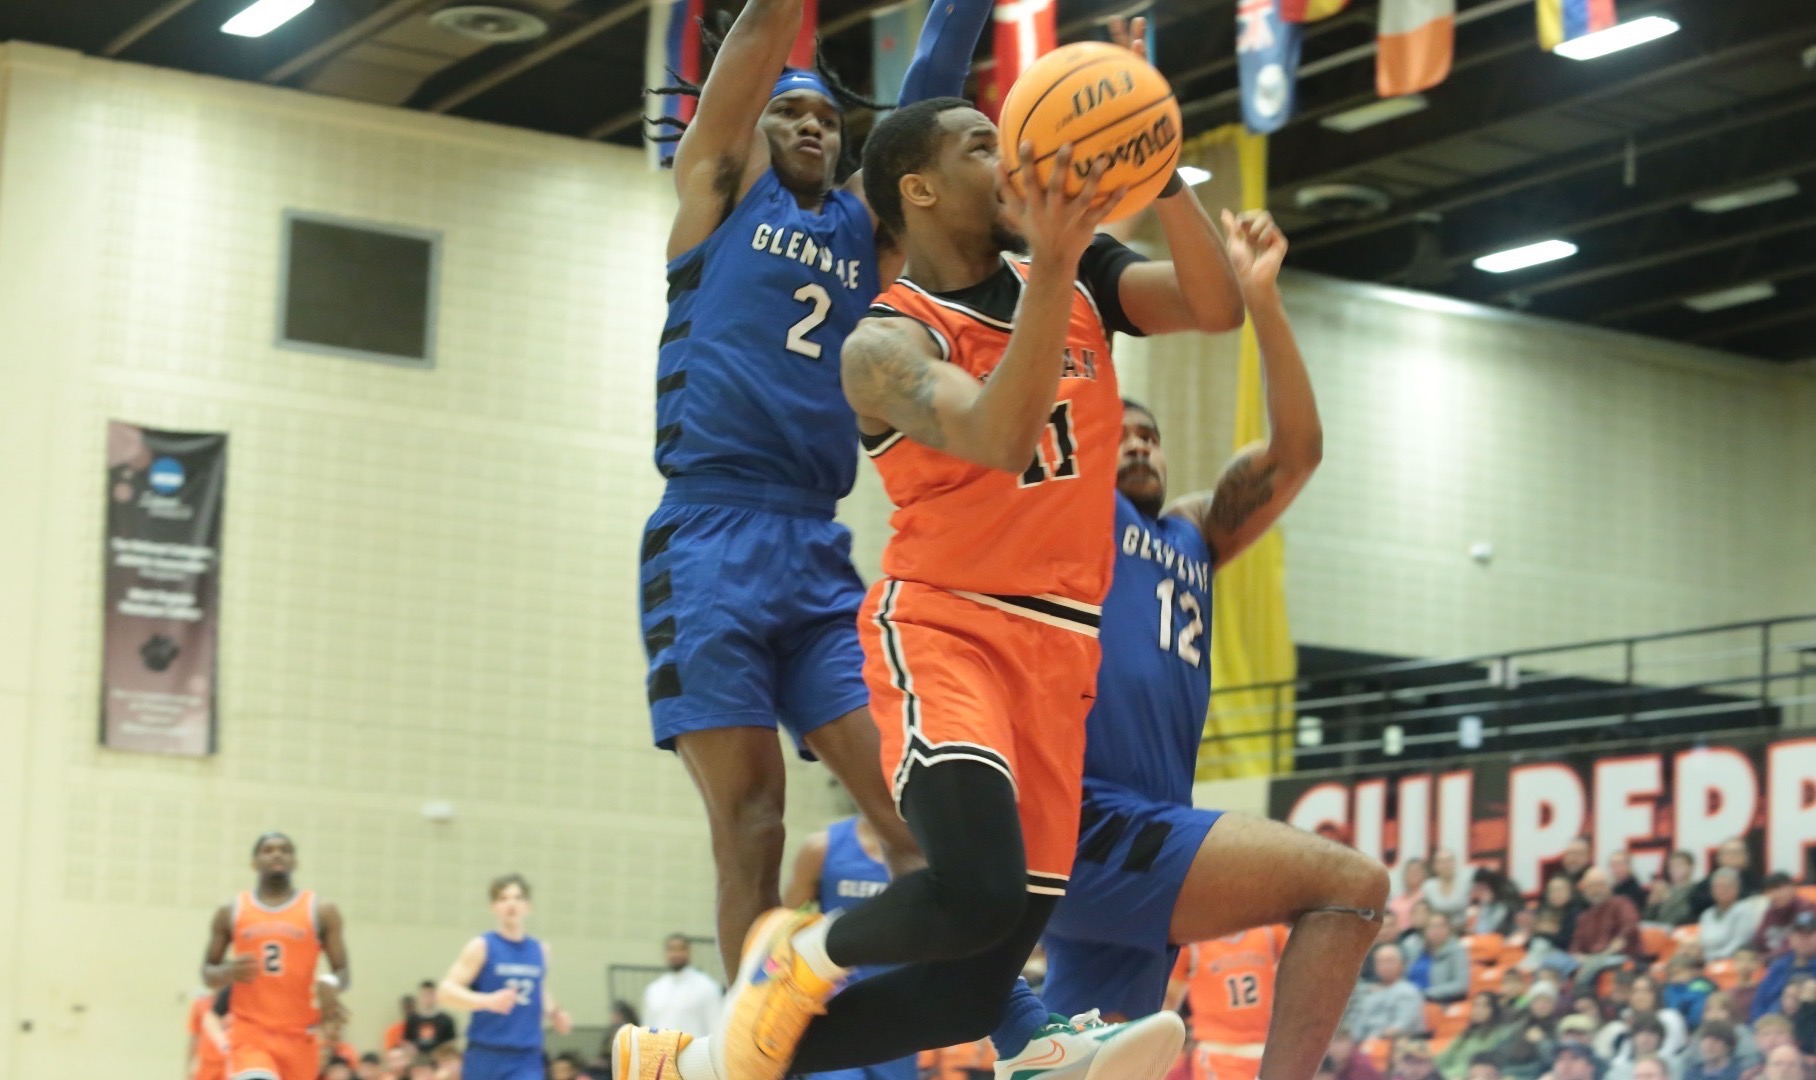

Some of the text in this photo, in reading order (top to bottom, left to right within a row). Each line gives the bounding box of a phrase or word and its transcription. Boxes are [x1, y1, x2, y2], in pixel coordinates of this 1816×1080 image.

[785, 282, 832, 360] 2
[1156, 577, 1204, 669] 12
[263, 942, 284, 974] 2
[1226, 972, 1261, 1009] 12
